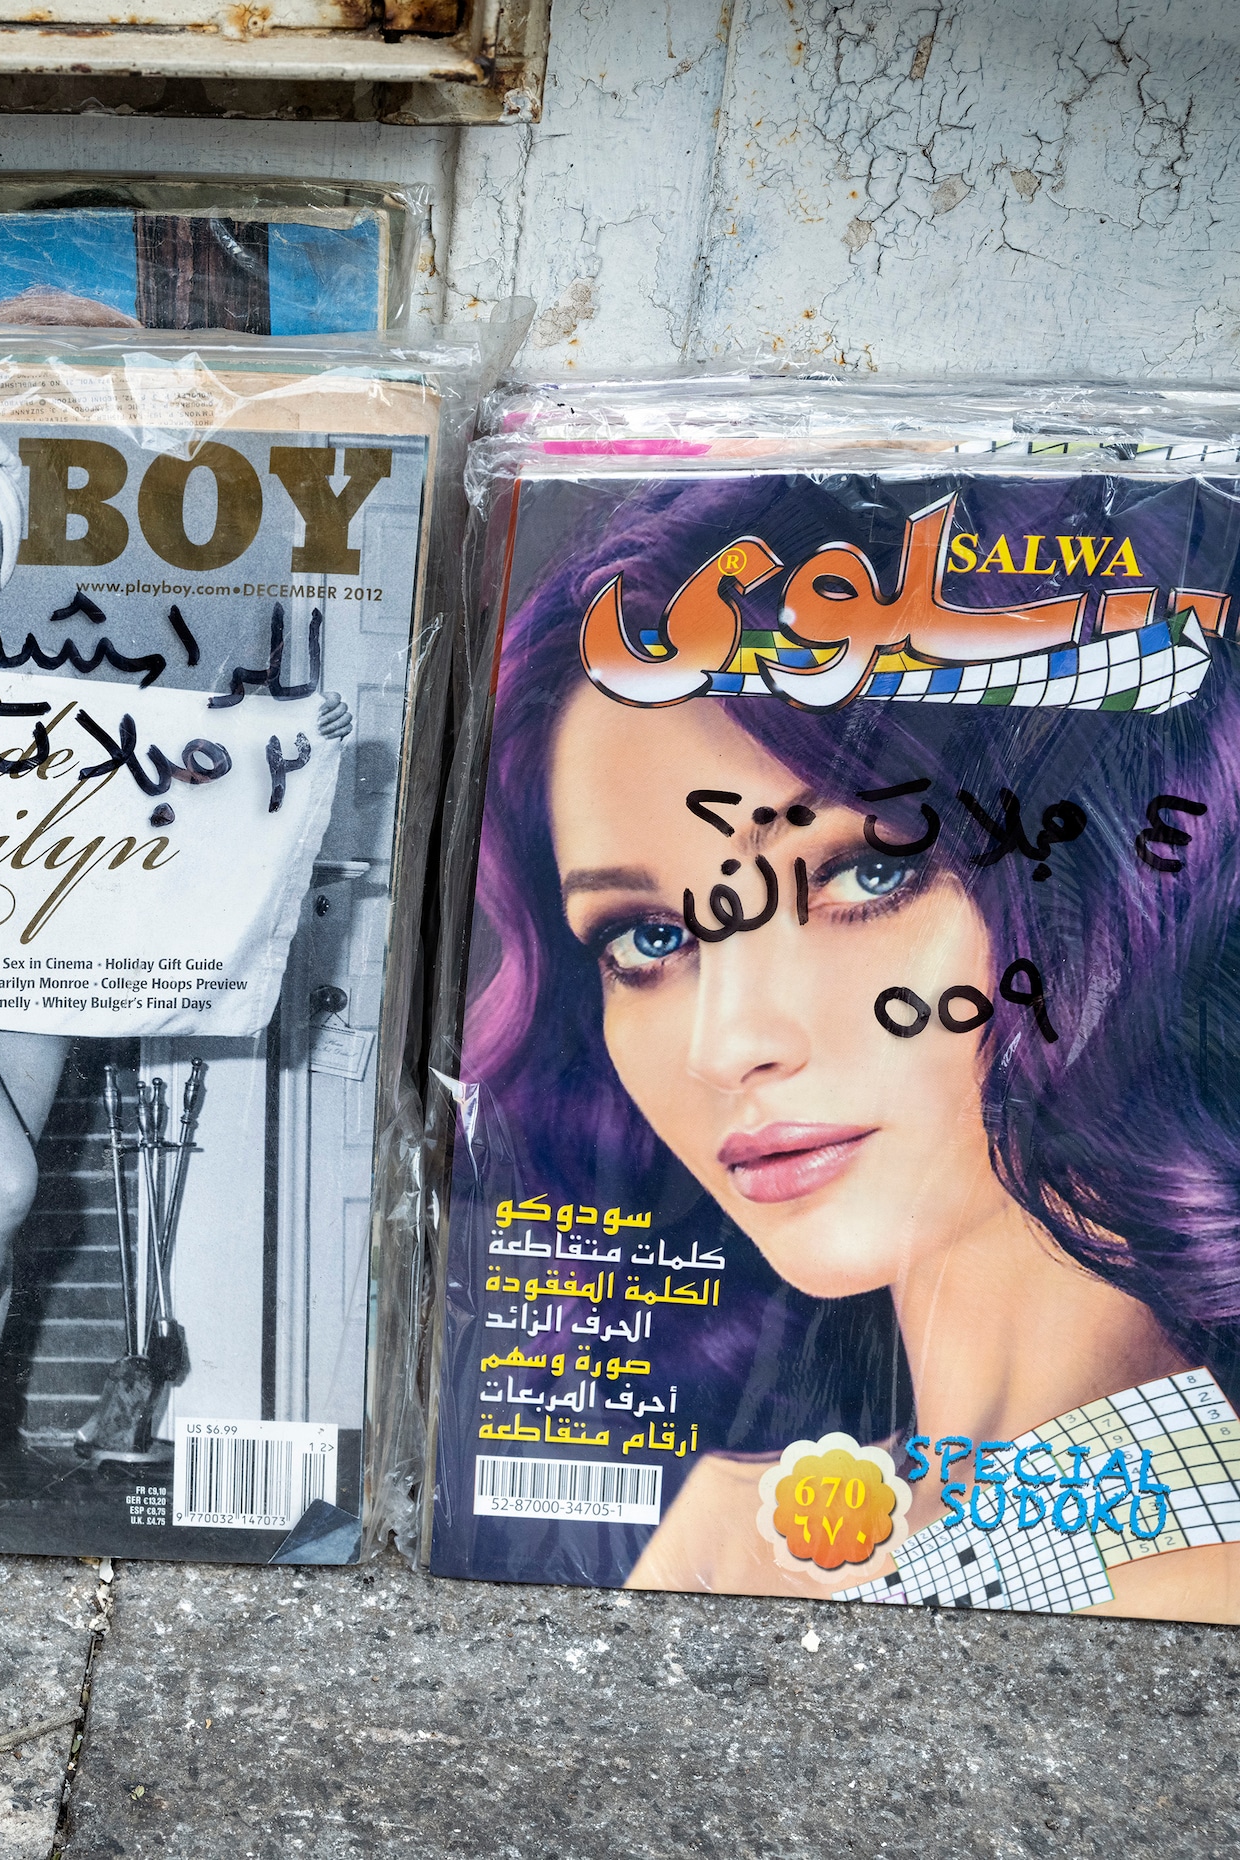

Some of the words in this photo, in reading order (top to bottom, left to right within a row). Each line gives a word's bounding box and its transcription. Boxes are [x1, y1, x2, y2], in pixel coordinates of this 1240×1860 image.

[947, 534, 1144, 578] SALWA
[344, 586, 383, 602] 2012
[577, 488, 1232, 714] سلوى
[2, 958, 25, 970] Sex
[29, 957, 41, 970] in
[45, 957, 93, 970] Cinema
[105, 958, 155, 972] Holiday
[159, 958, 182, 971] Gift
[185, 958, 223, 971] Guide
[39, 977, 89, 990] Monroe
[101, 977, 148, 993] College
[151, 978, 192, 993] Hoops
[196, 978, 248, 991] Preview
[42, 996, 87, 1011] Whitey
[91, 997, 142, 1012] Bulger's
[146, 997, 177, 1010] Final
[181, 997, 212, 1012] Days
[496, 1193, 652, 1235] سودوكو
[489, 1229, 622, 1263] متقاطعة
[630, 1238, 726, 1271] كلمات
[485, 1265, 615, 1303] المفقودة
[624, 1275, 720, 1307] الكلمة
[485, 1303, 562, 1337] الزائد
[571, 1307, 652, 1343] الحرف
[480, 1346, 565, 1377] وسهم
[575, 1344, 651, 1380] صورة
[479, 1375, 596, 1413] المربعات
[605, 1383, 677, 1418] أحرف
[187, 1423, 202, 1434] US
[206, 1423, 238, 1435] $6.99
[478, 1413, 610, 1446] متقاطعة
[622, 1421, 698, 1457] أرقام
[905, 1435, 1171, 1498] SPECIAL
[126, 1496, 142, 1505] GER
[136, 1486, 146, 1495] FR
[491, 1497, 623, 1517] 52-87000-34705-1
[794, 1475, 866, 1510] 670
[130, 1506, 145, 1515] ESP
[176, 1513, 183, 1522] 9
[190, 1513, 233, 1524] 770032
[241, 1515, 286, 1526] 147073
[940, 1483, 1168, 1540] SUDOKU
[794, 1513, 867, 1546] ٦٧٠
